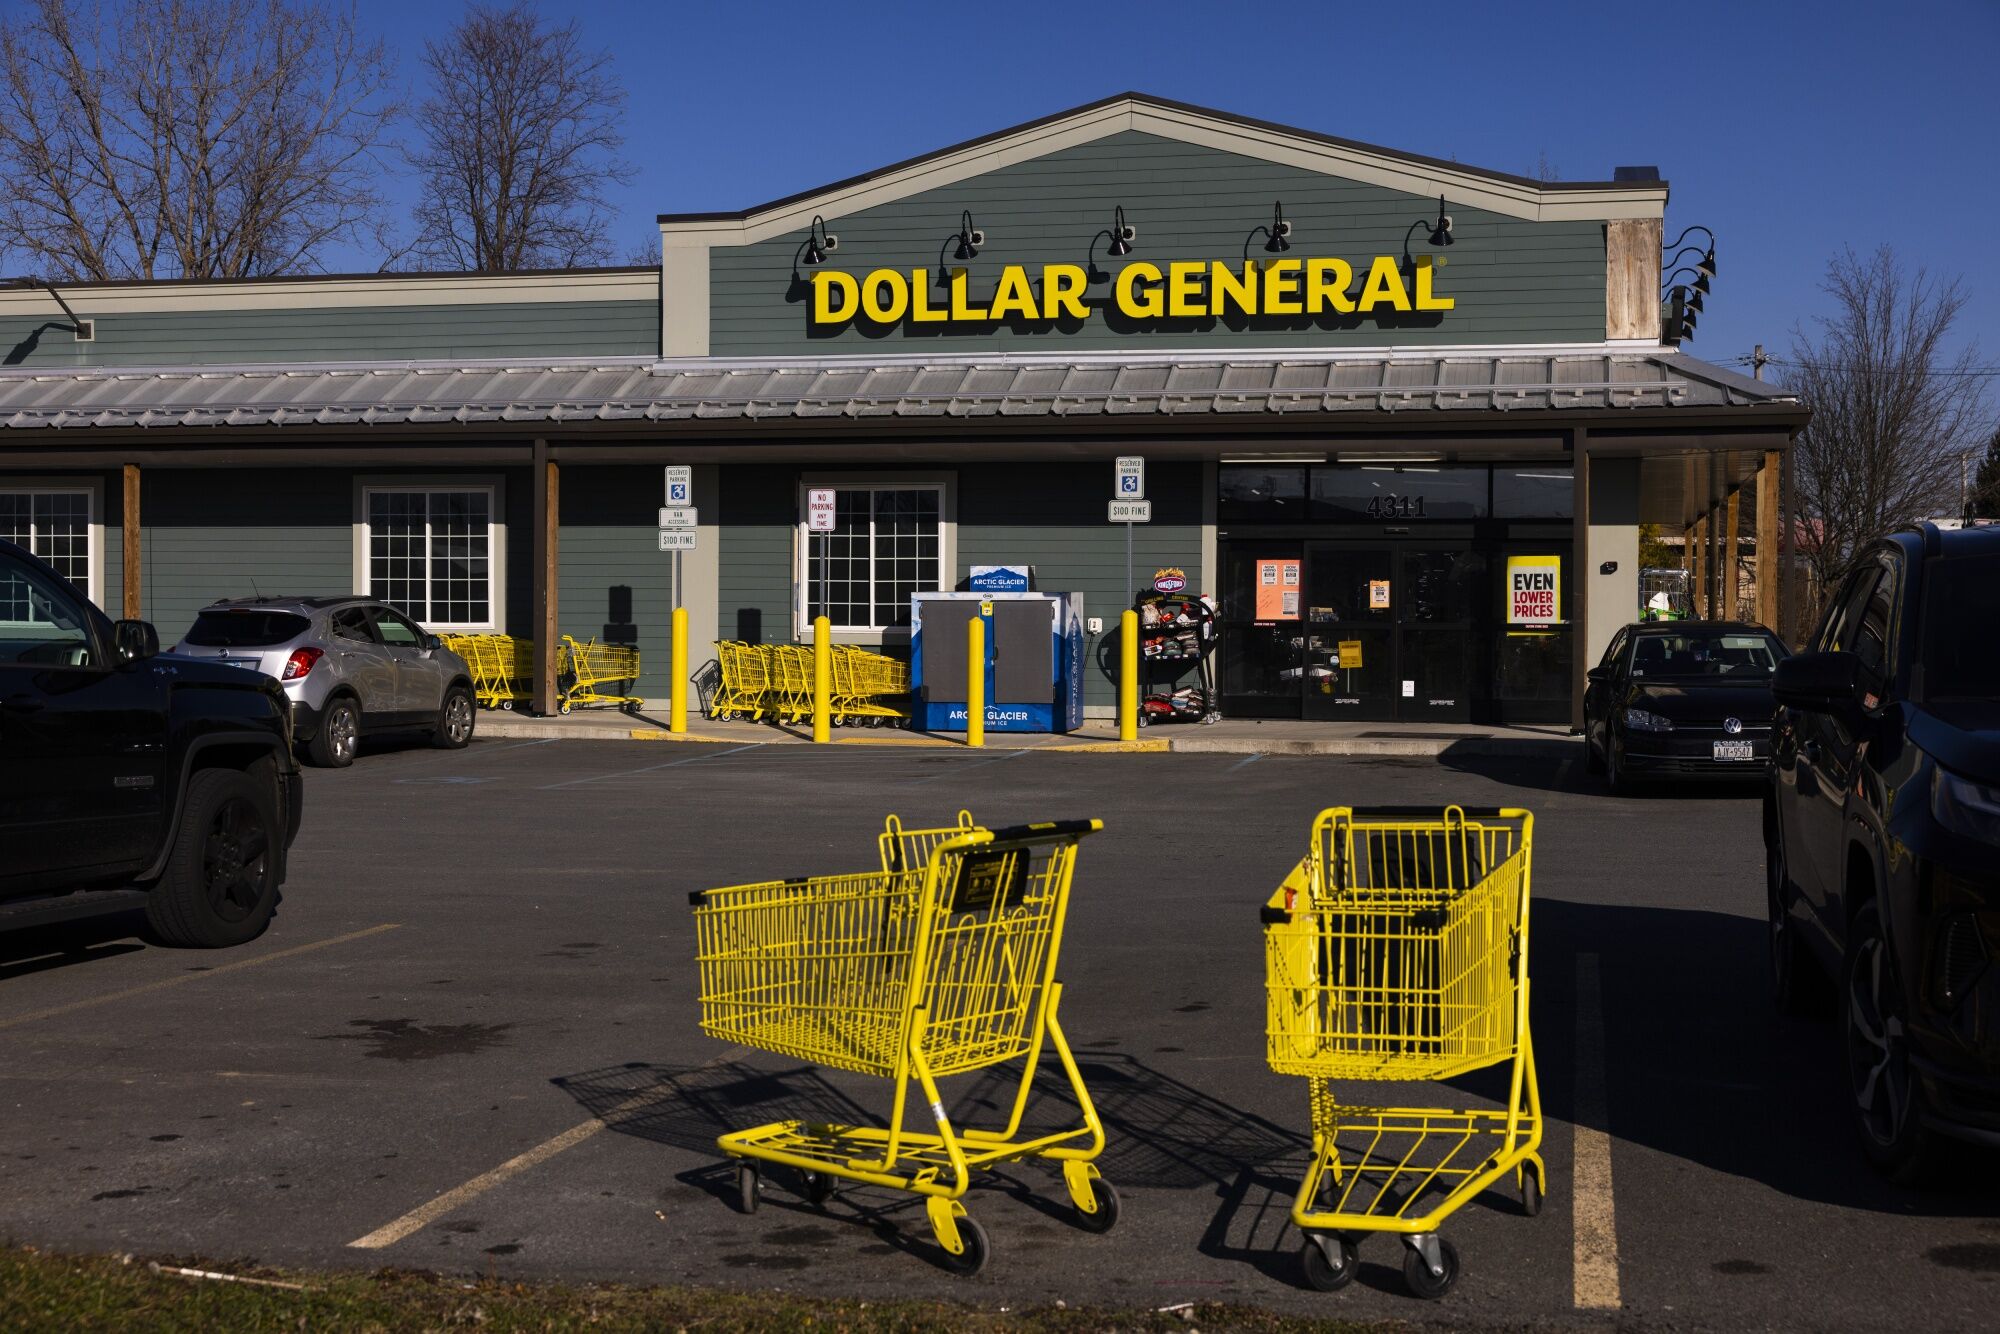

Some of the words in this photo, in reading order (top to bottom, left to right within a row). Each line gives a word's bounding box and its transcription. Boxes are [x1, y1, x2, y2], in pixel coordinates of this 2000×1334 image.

[812, 264, 1091, 325] DOLLAR
[1115, 255, 1455, 319] GENERAL
[1113, 506, 1129, 516] $100
[1131, 506, 1147, 515] FINE
[1367, 495, 1427, 519] 4311
[663, 536, 678, 545] $100
[679, 536, 694, 545] FINE
[1157, 580, 1183, 589] KINGSFORD
[1513, 573, 1554, 591] EVEN
[1514, 591, 1554, 604] LOWER
[1514, 605, 1554, 618] PRICES
[987, 712, 1028, 720] GLACIER
